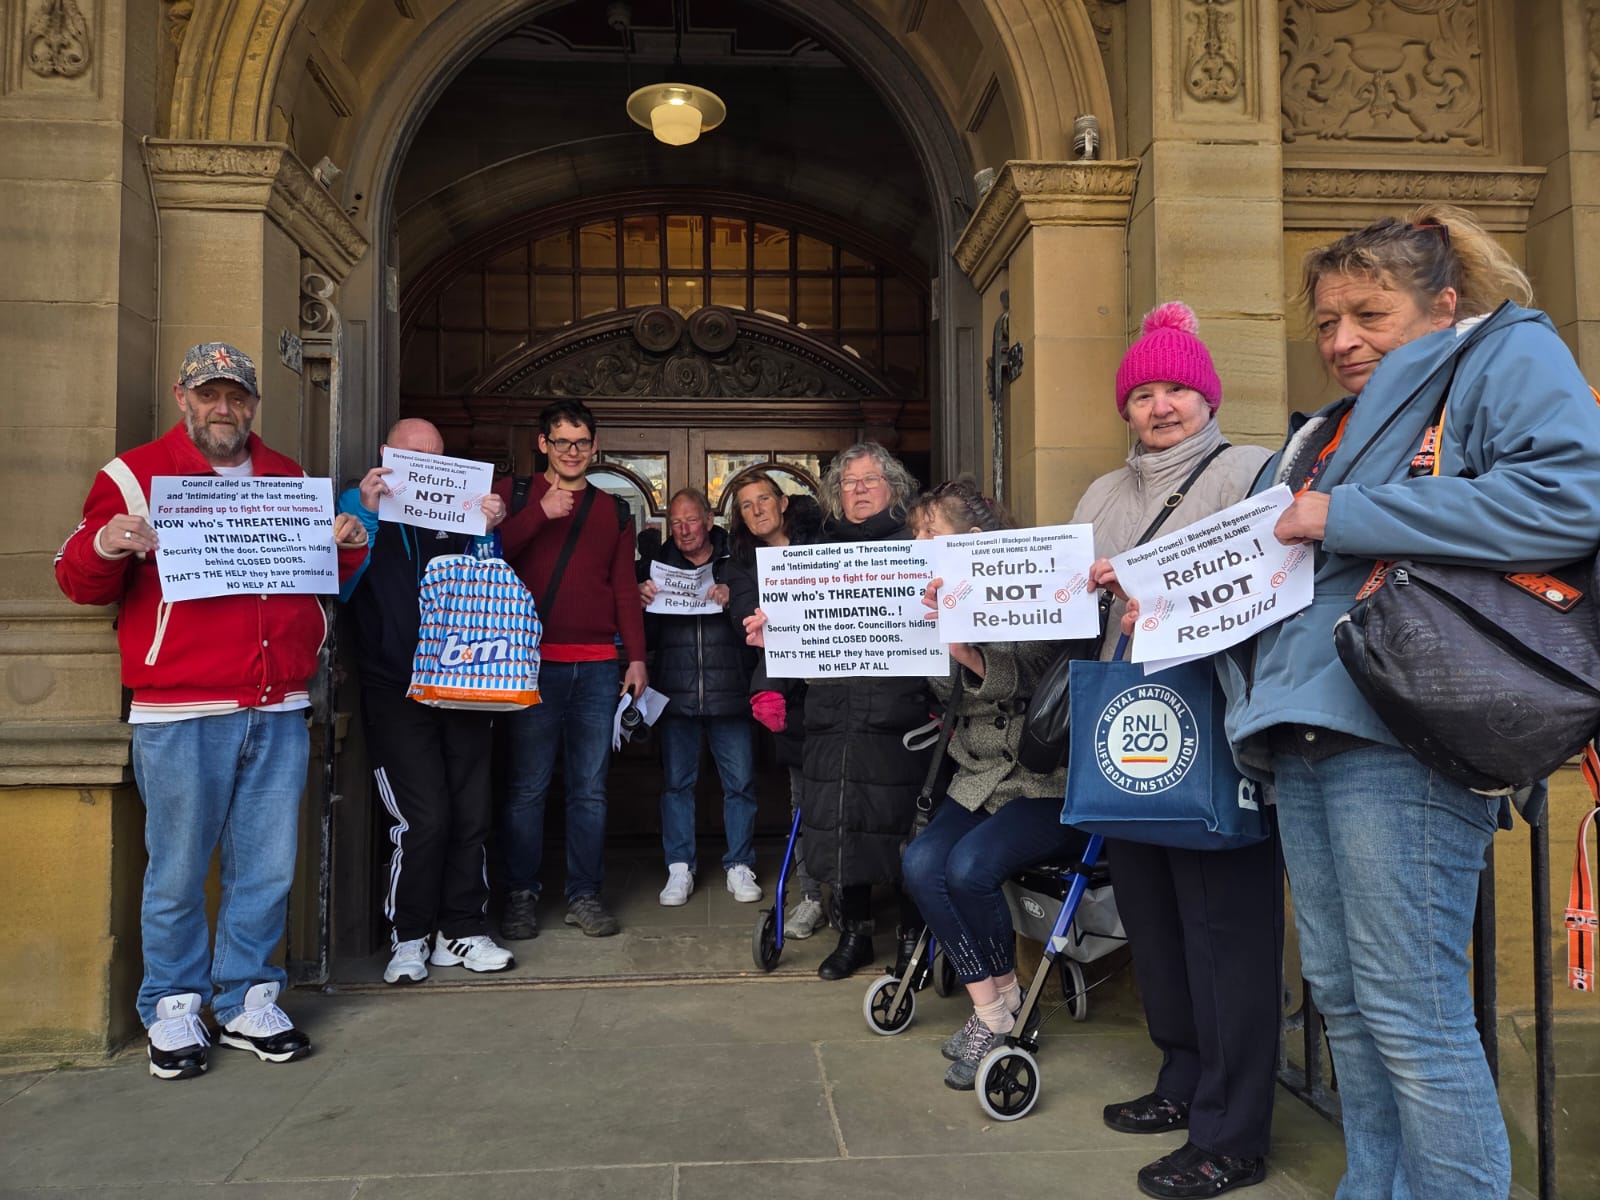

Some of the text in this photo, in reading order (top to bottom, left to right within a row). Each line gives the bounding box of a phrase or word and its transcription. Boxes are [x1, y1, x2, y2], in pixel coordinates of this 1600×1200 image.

[409, 471, 466, 489] Refurb..!
[185, 493, 238, 501] 'Intimidating'
[284, 493, 318, 501] meeting.
[416, 490, 455, 504] NOT
[175, 506, 213, 514] standing
[241, 505, 260, 514] fight
[405, 505, 465, 522] Re-build
[154, 518, 332, 529] NOW who's THREATENING and
[1002, 537, 1031, 545] Blackpool
[1127, 547, 1158, 566] Blackpool
[1159, 538, 1184, 553] Council
[1188, 524, 1221, 541] Blackpool
[1222, 504, 1278, 526] Regeneration...
[163, 547, 202, 556] Security
[237, 546, 258, 554] door.
[261, 545, 306, 553] Councillors
[309, 545, 331, 553] hiding
[783, 549, 813, 557] Council
[816, 547, 841, 555] called
[856, 544, 912, 554] 'Threatening'
[1158, 525, 1250, 566] LEAVE OUR HOMES ALONE!
[787, 561, 841, 570] 'Intimidating'
[871, 558, 887, 566] last
[890, 558, 928, 566] meeting.
[972, 557, 1055, 576] Refurb..!
[1163, 538, 1264, 590] Refurb..!
[165, 572, 200, 583] THAT'S
[250, 570, 268, 578] they
[293, 568, 324, 577] promised
[780, 576, 816, 586] standing
[844, 574, 863, 583] fight
[866, 573, 877, 581] for
[898, 571, 933, 580] homes.!
[763, 592, 788, 602] NOW
[792, 590, 824, 601] who's
[828, 587, 915, 599] THREATENING
[986, 584, 1042, 601] NOT
[1188, 575, 1254, 613] NOT
[974, 609, 1062, 627] Re-build
[1178, 593, 1277, 643] Re-build
[768, 624, 800, 634] Security
[803, 623, 815, 631] ON
[834, 622, 855, 630] door.
[858, 621, 906, 629] Councillors
[909, 620, 935, 628] hiding
[802, 635, 902, 645] behind CLOSED DOORS.
[440, 633, 507, 666] b&m
[769, 651, 797, 659] THAT'S
[844, 650, 863, 658] they
[865, 649, 884, 657] have
[887, 648, 927, 657] promised
[873, 662, 889, 670] ALL
[1104, 693, 1135, 723] ROYAL
[1139, 688, 1188, 719] NATIONAL
[1123, 714, 1167, 732] RNLI
[1097, 741, 1132, 789] LIFEBOAT
[1136, 737, 1195, 791] INSTITUTION
